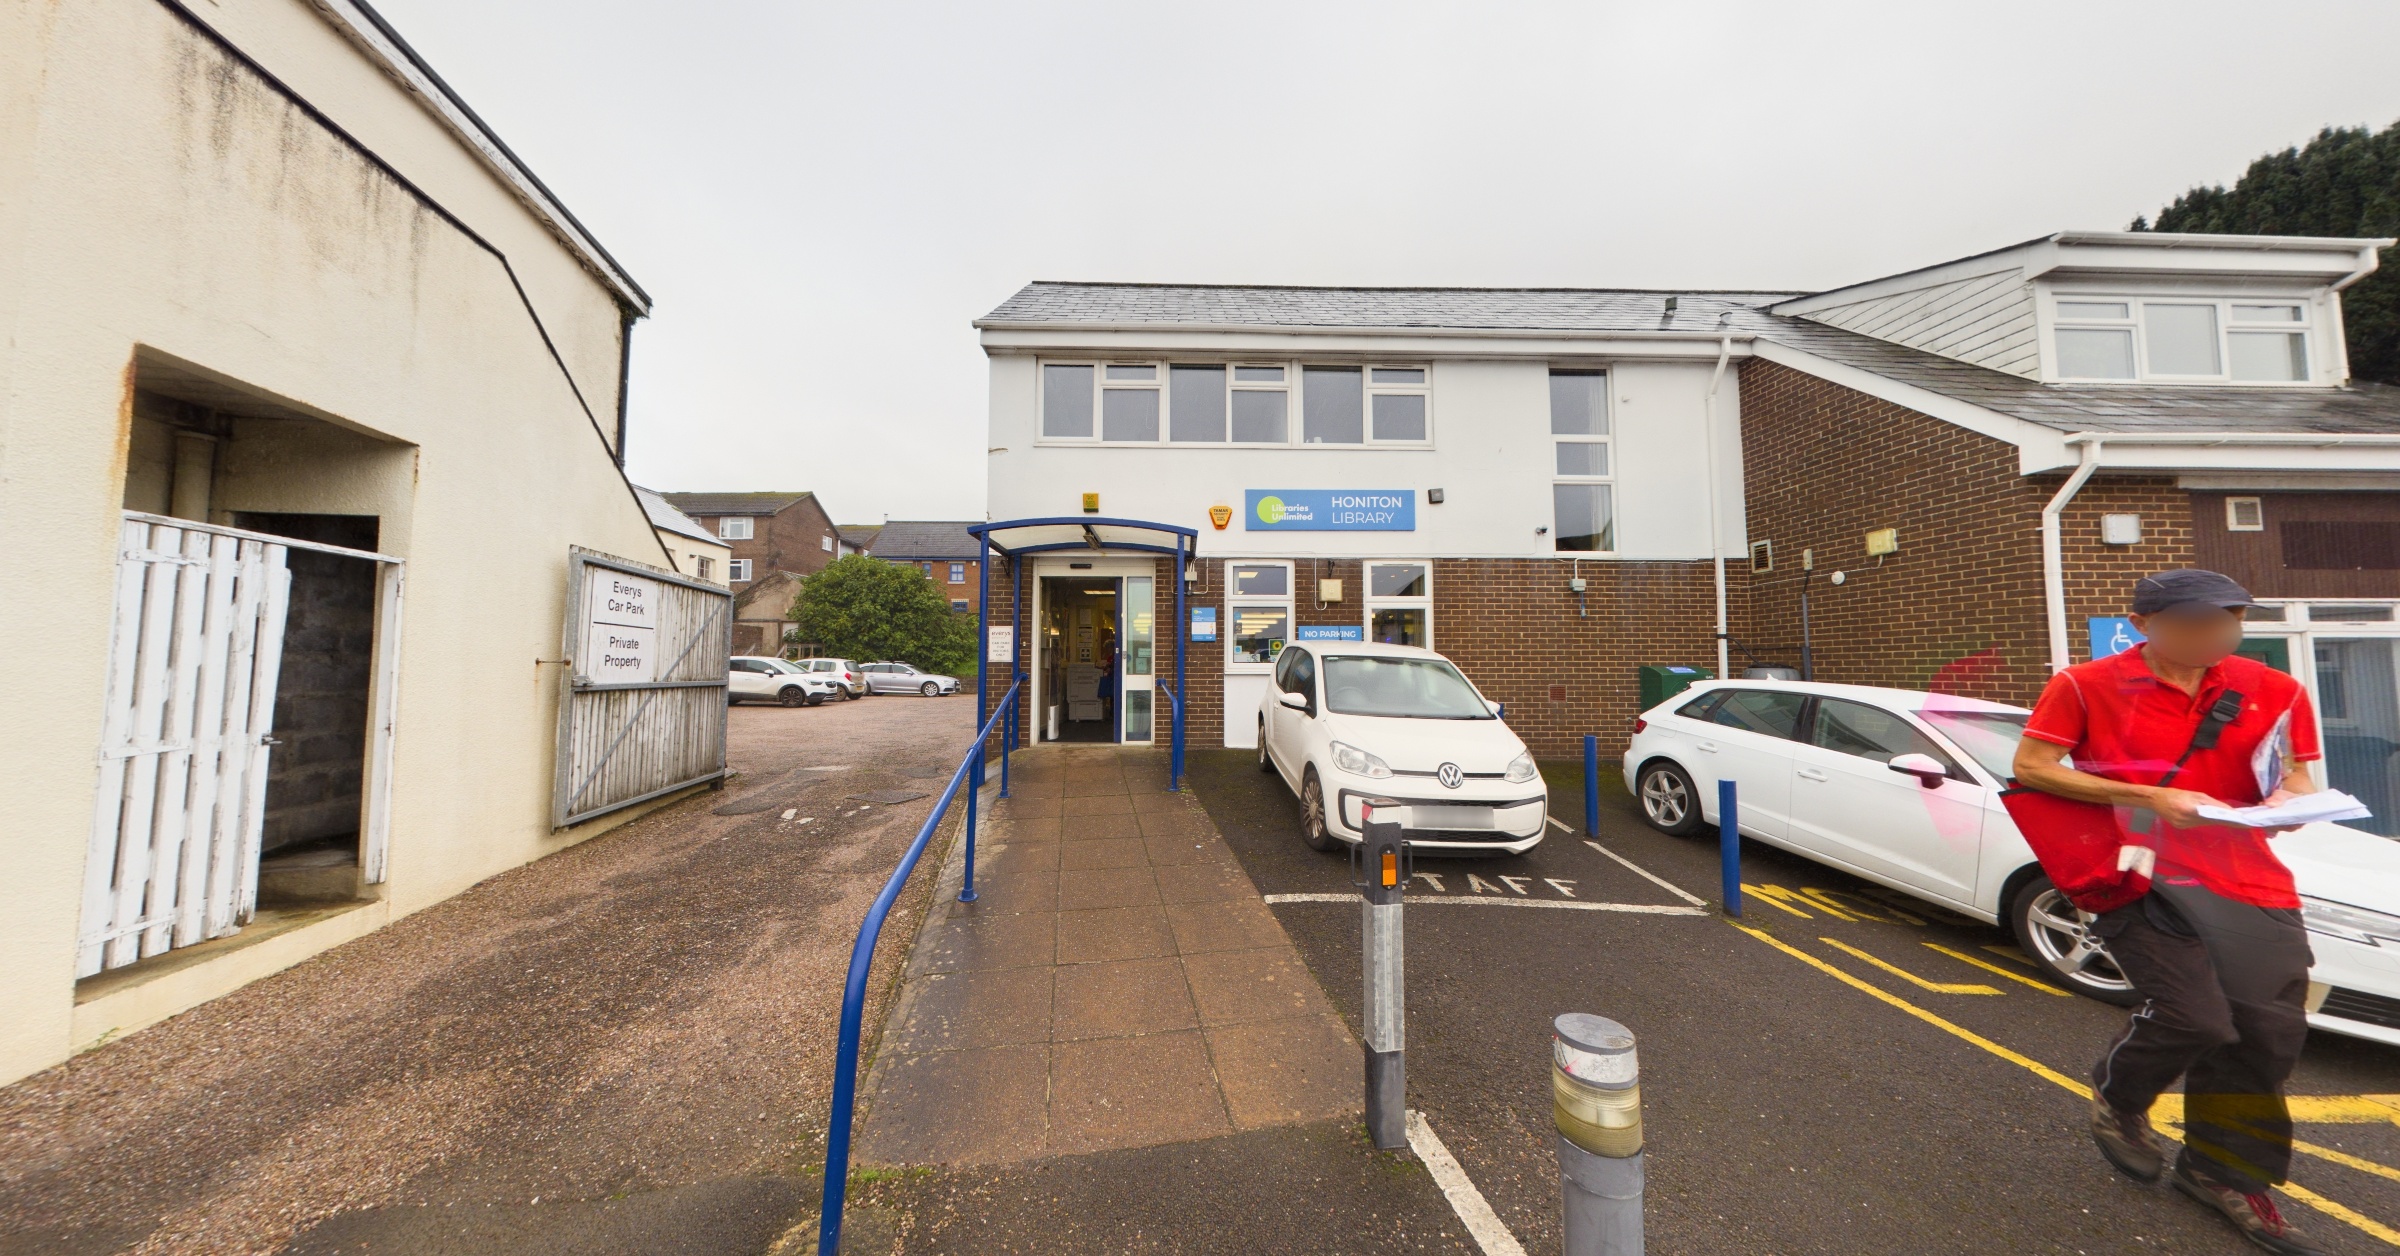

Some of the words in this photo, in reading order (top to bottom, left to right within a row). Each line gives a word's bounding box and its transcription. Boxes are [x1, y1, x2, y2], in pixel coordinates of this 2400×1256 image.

[1271, 504, 1309, 512] Libraries
[1331, 496, 1402, 508] HONITON
[1271, 512, 1313, 521] Unlimited
[1332, 512, 1394, 524] LIBRARY
[613, 581, 642, 599] Everys
[608, 598, 624, 612] Car
[626, 601, 645, 615] Park
[1304, 630, 1318, 638] NO
[1319, 630, 1356, 638] PARKING
[609, 636, 640, 649] Private
[604, 654, 641, 670] Property
[1402, 872, 1578, 898] TAFF
